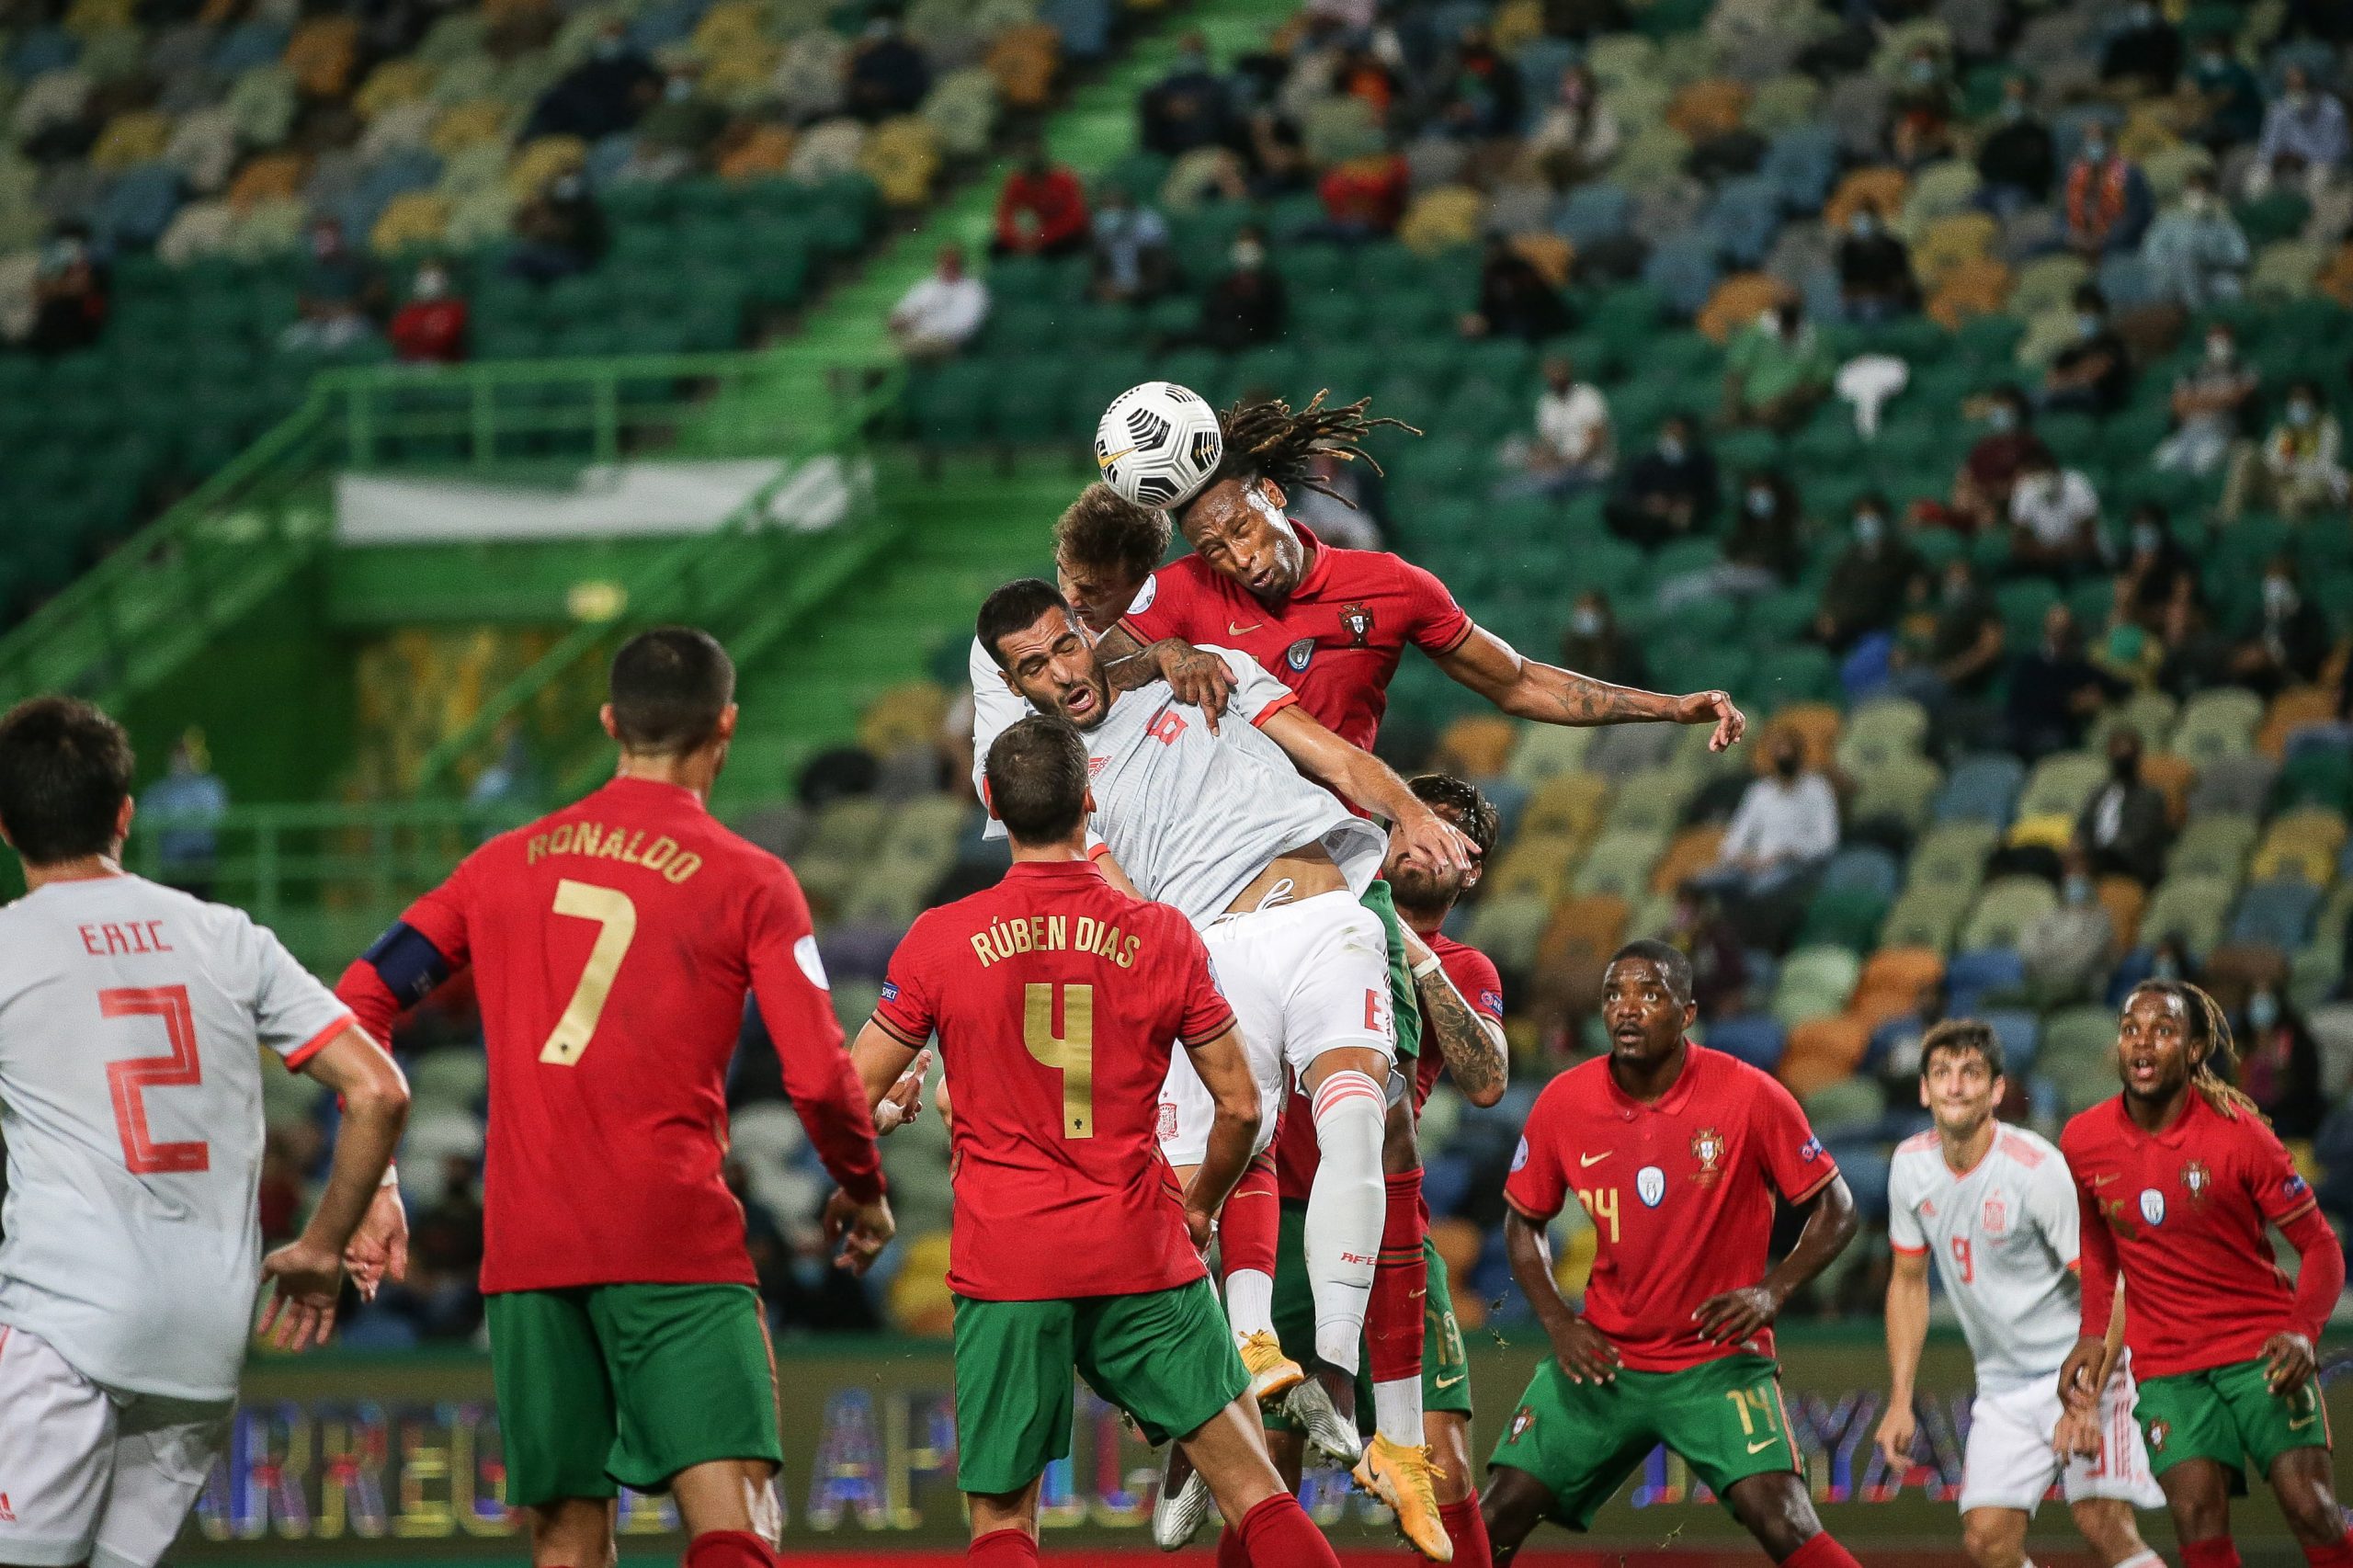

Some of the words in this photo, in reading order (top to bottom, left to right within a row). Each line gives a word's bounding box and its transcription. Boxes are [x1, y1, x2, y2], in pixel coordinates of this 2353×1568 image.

[1089, 755, 1113, 781] adidas
[527, 822, 703, 884] RONALDO
[78, 920, 173, 956] ERIC
[970, 915, 1066, 968] RÚBEN
[1074, 916, 1142, 969] DIAS
[539, 878, 637, 1067] 7
[97, 983, 210, 1176] 2
[1023, 983, 1094, 1140] 4
[1951, 1236, 1974, 1285] 9
[1725, 1385, 1778, 1436] 14
